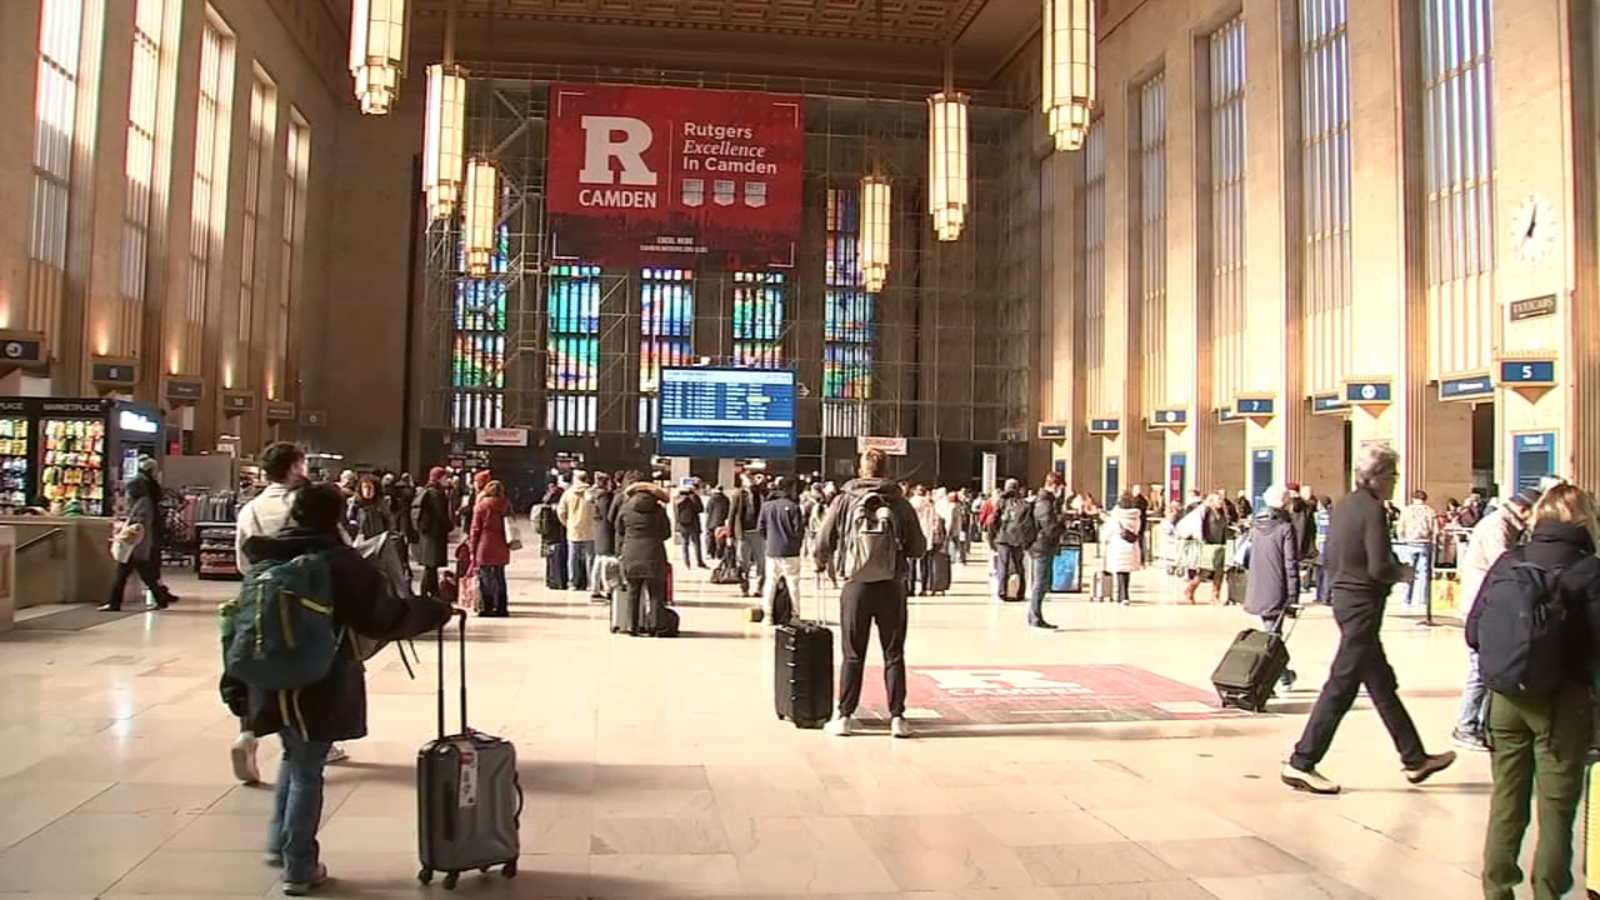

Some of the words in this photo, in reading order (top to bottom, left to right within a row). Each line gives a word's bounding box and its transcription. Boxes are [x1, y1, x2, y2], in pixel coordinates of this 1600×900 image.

[684, 122, 753, 140] Rutgers
[579, 115, 658, 186] R
[682, 140, 766, 157] Excellence
[683, 156, 699, 171] In
[704, 157, 778, 175] Camden
[579, 189, 657, 209] CAMDEN
[1522, 365, 1533, 379] 5
[43, 403, 102, 413] MARKETPLACE
